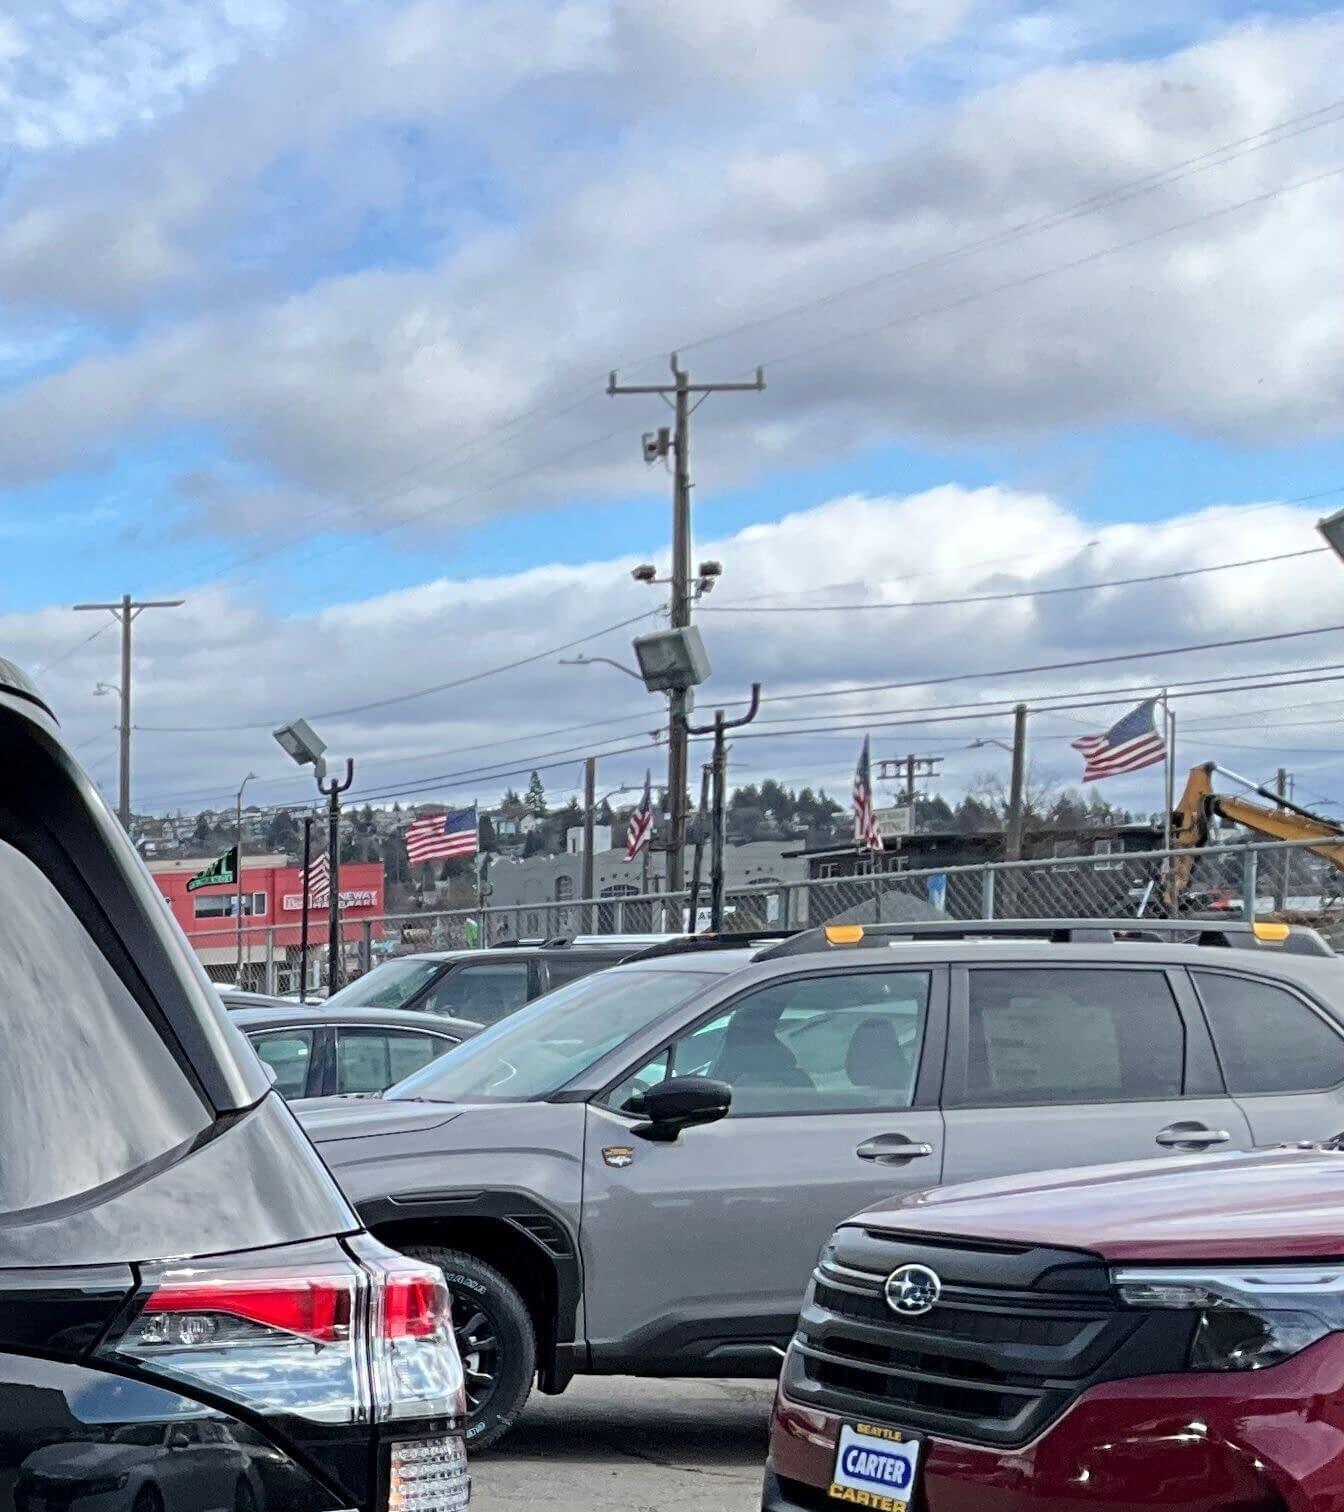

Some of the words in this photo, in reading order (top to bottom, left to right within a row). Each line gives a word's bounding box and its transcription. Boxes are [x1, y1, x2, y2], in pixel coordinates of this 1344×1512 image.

[313, 899, 378, 910] HADWARE
[856, 1423, 902, 1441] SEATTLE
[846, 1449, 906, 1483] CARTER
